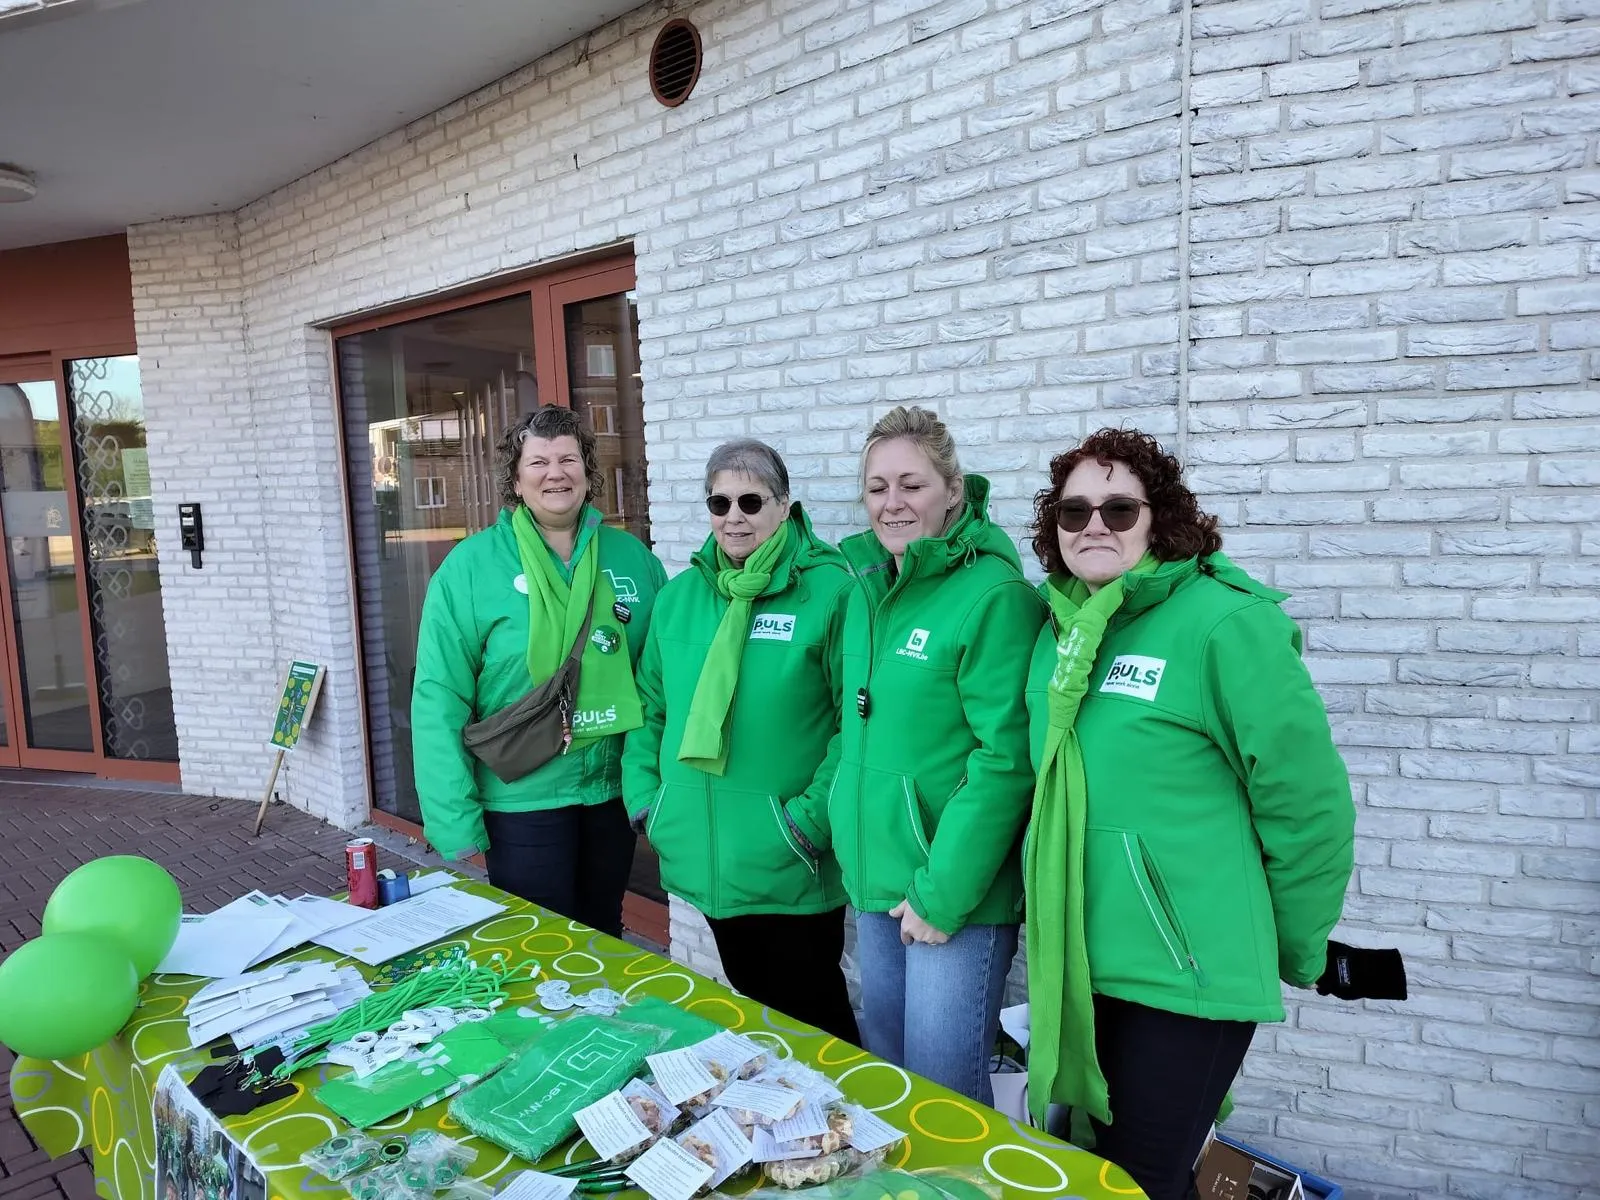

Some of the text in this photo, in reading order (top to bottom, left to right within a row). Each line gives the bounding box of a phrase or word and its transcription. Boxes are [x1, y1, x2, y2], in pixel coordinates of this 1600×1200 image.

[753, 619, 793, 632] PULS
[1108, 664, 1158, 686] PULS
[572, 707, 617, 728] PULS
